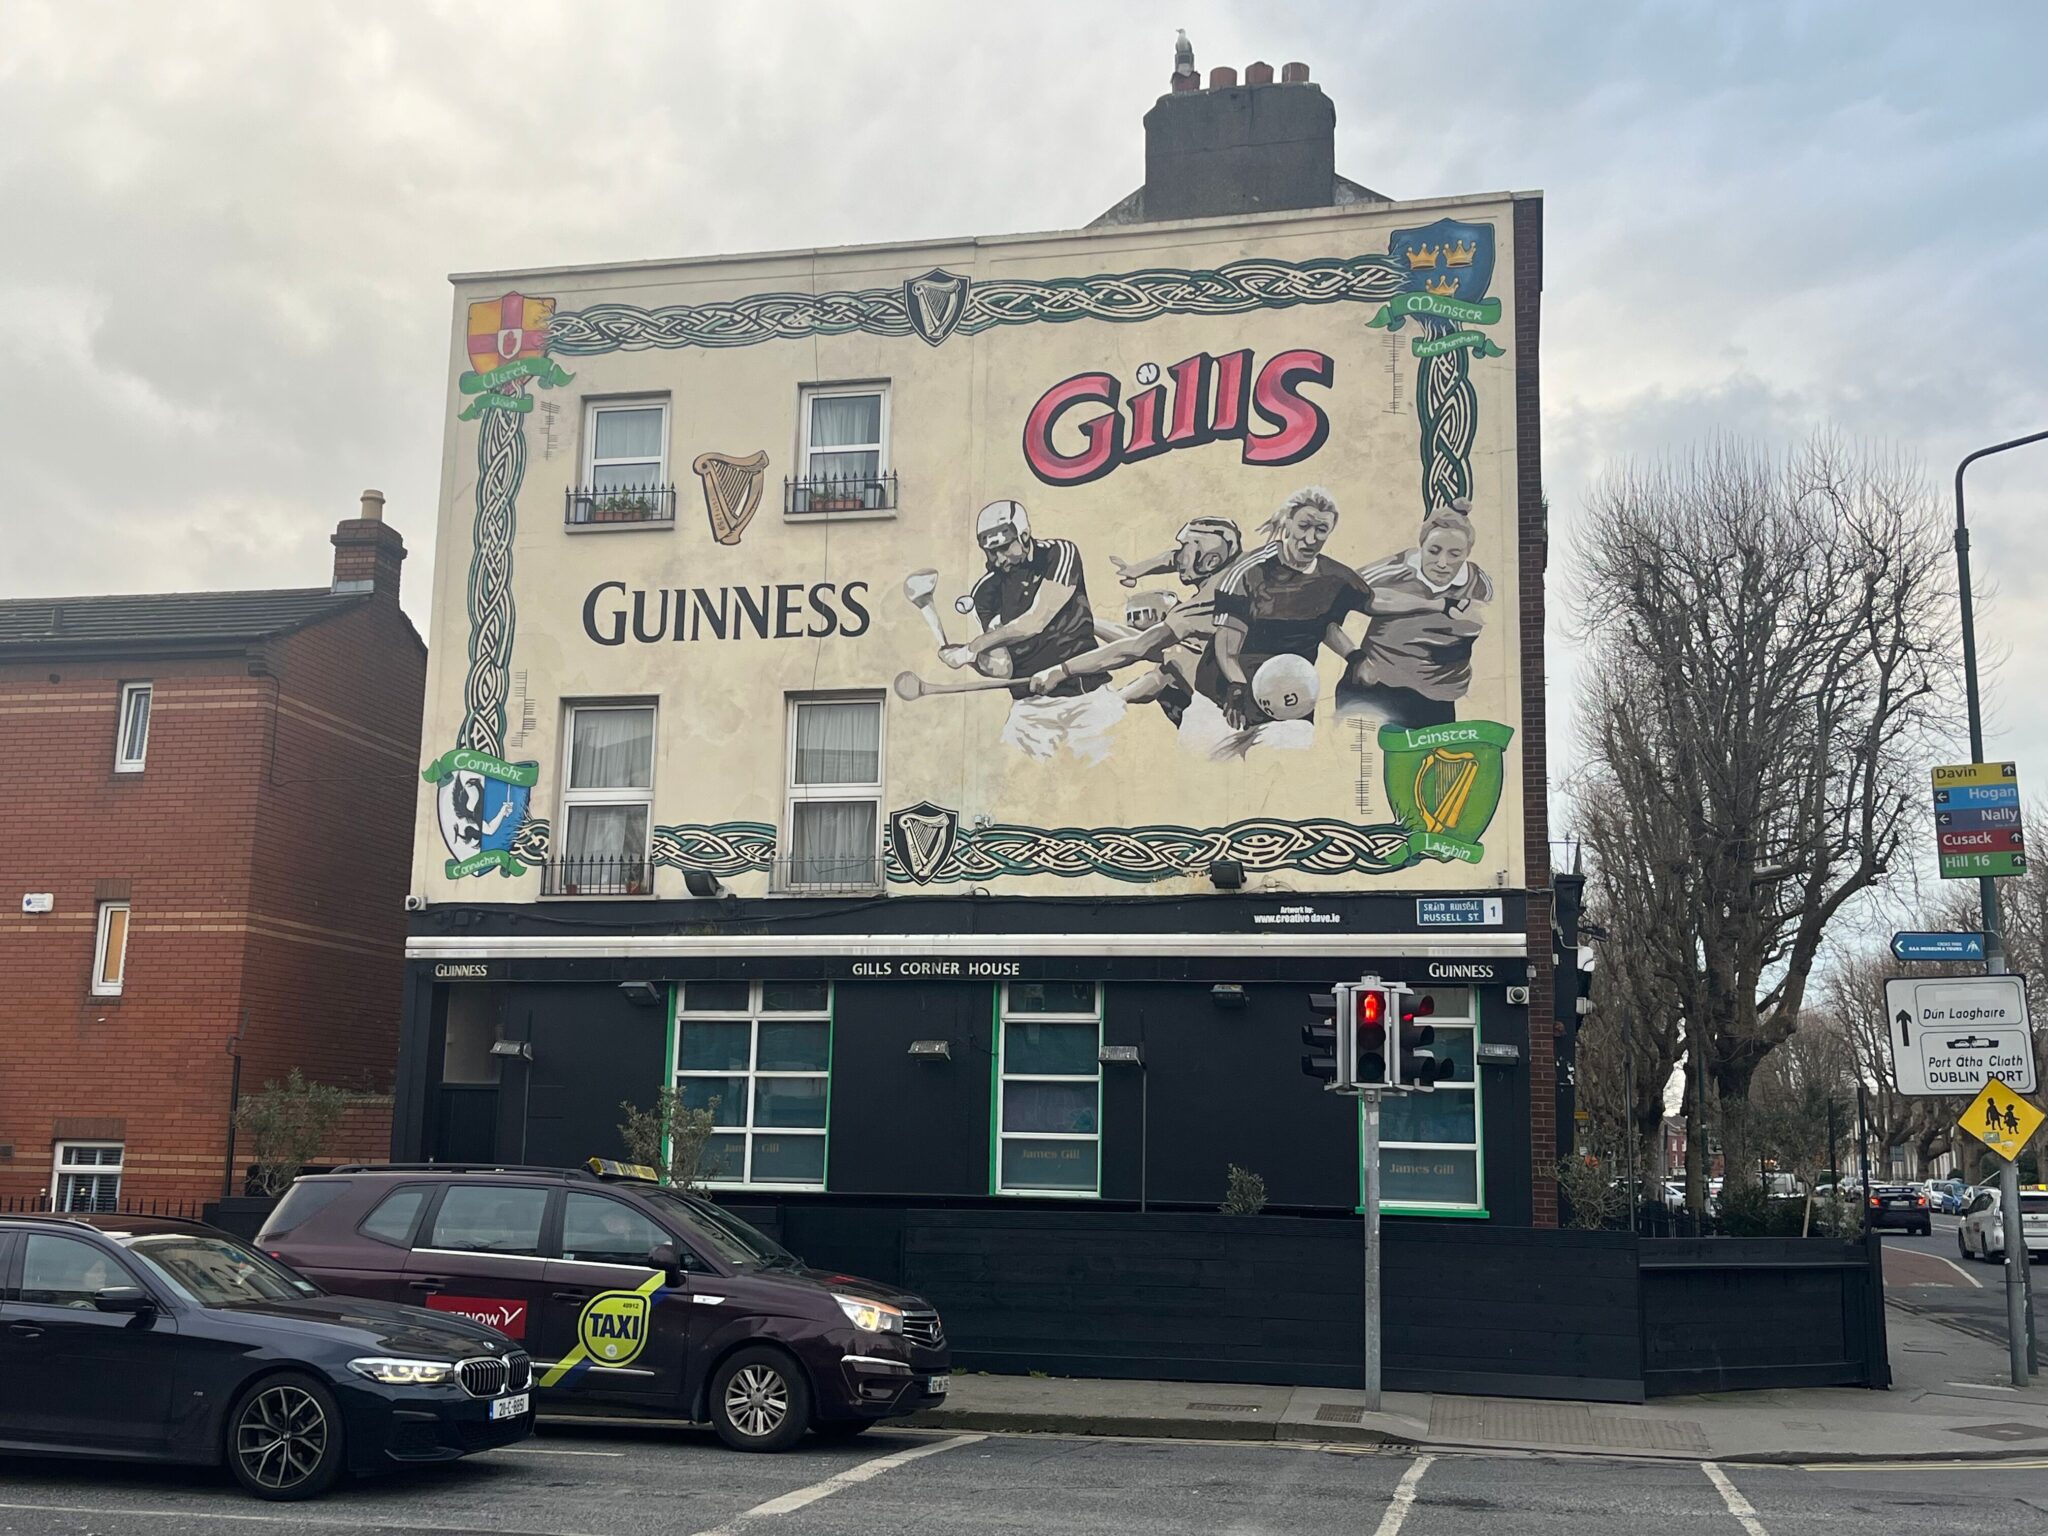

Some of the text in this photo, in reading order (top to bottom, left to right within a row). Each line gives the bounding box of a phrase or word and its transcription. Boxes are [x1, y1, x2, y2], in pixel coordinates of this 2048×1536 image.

[454, 752, 524, 781] Connacht
[1936, 768, 1977, 779] Davin
[1968, 787, 2017, 801] Hogan
[1981, 808, 2018, 823] Nally
[1942, 832, 1993, 846] Cusack
[1945, 854, 1991, 868] Hill 16
[1423, 913, 1462, 922] RUSSELL
[1490, 906, 1496, 917] 1
[852, 962, 1020, 976] GILLS CORNER HOUSE
[1428, 962, 1494, 978] GUINNESS
[1928, 1057, 1951, 1068] Port
[1929, 1070, 2024, 1084] DUBLIN PORT
[1388, 1163, 1456, 1175] James Gill
[588, 1312, 640, 1341] TAXI
